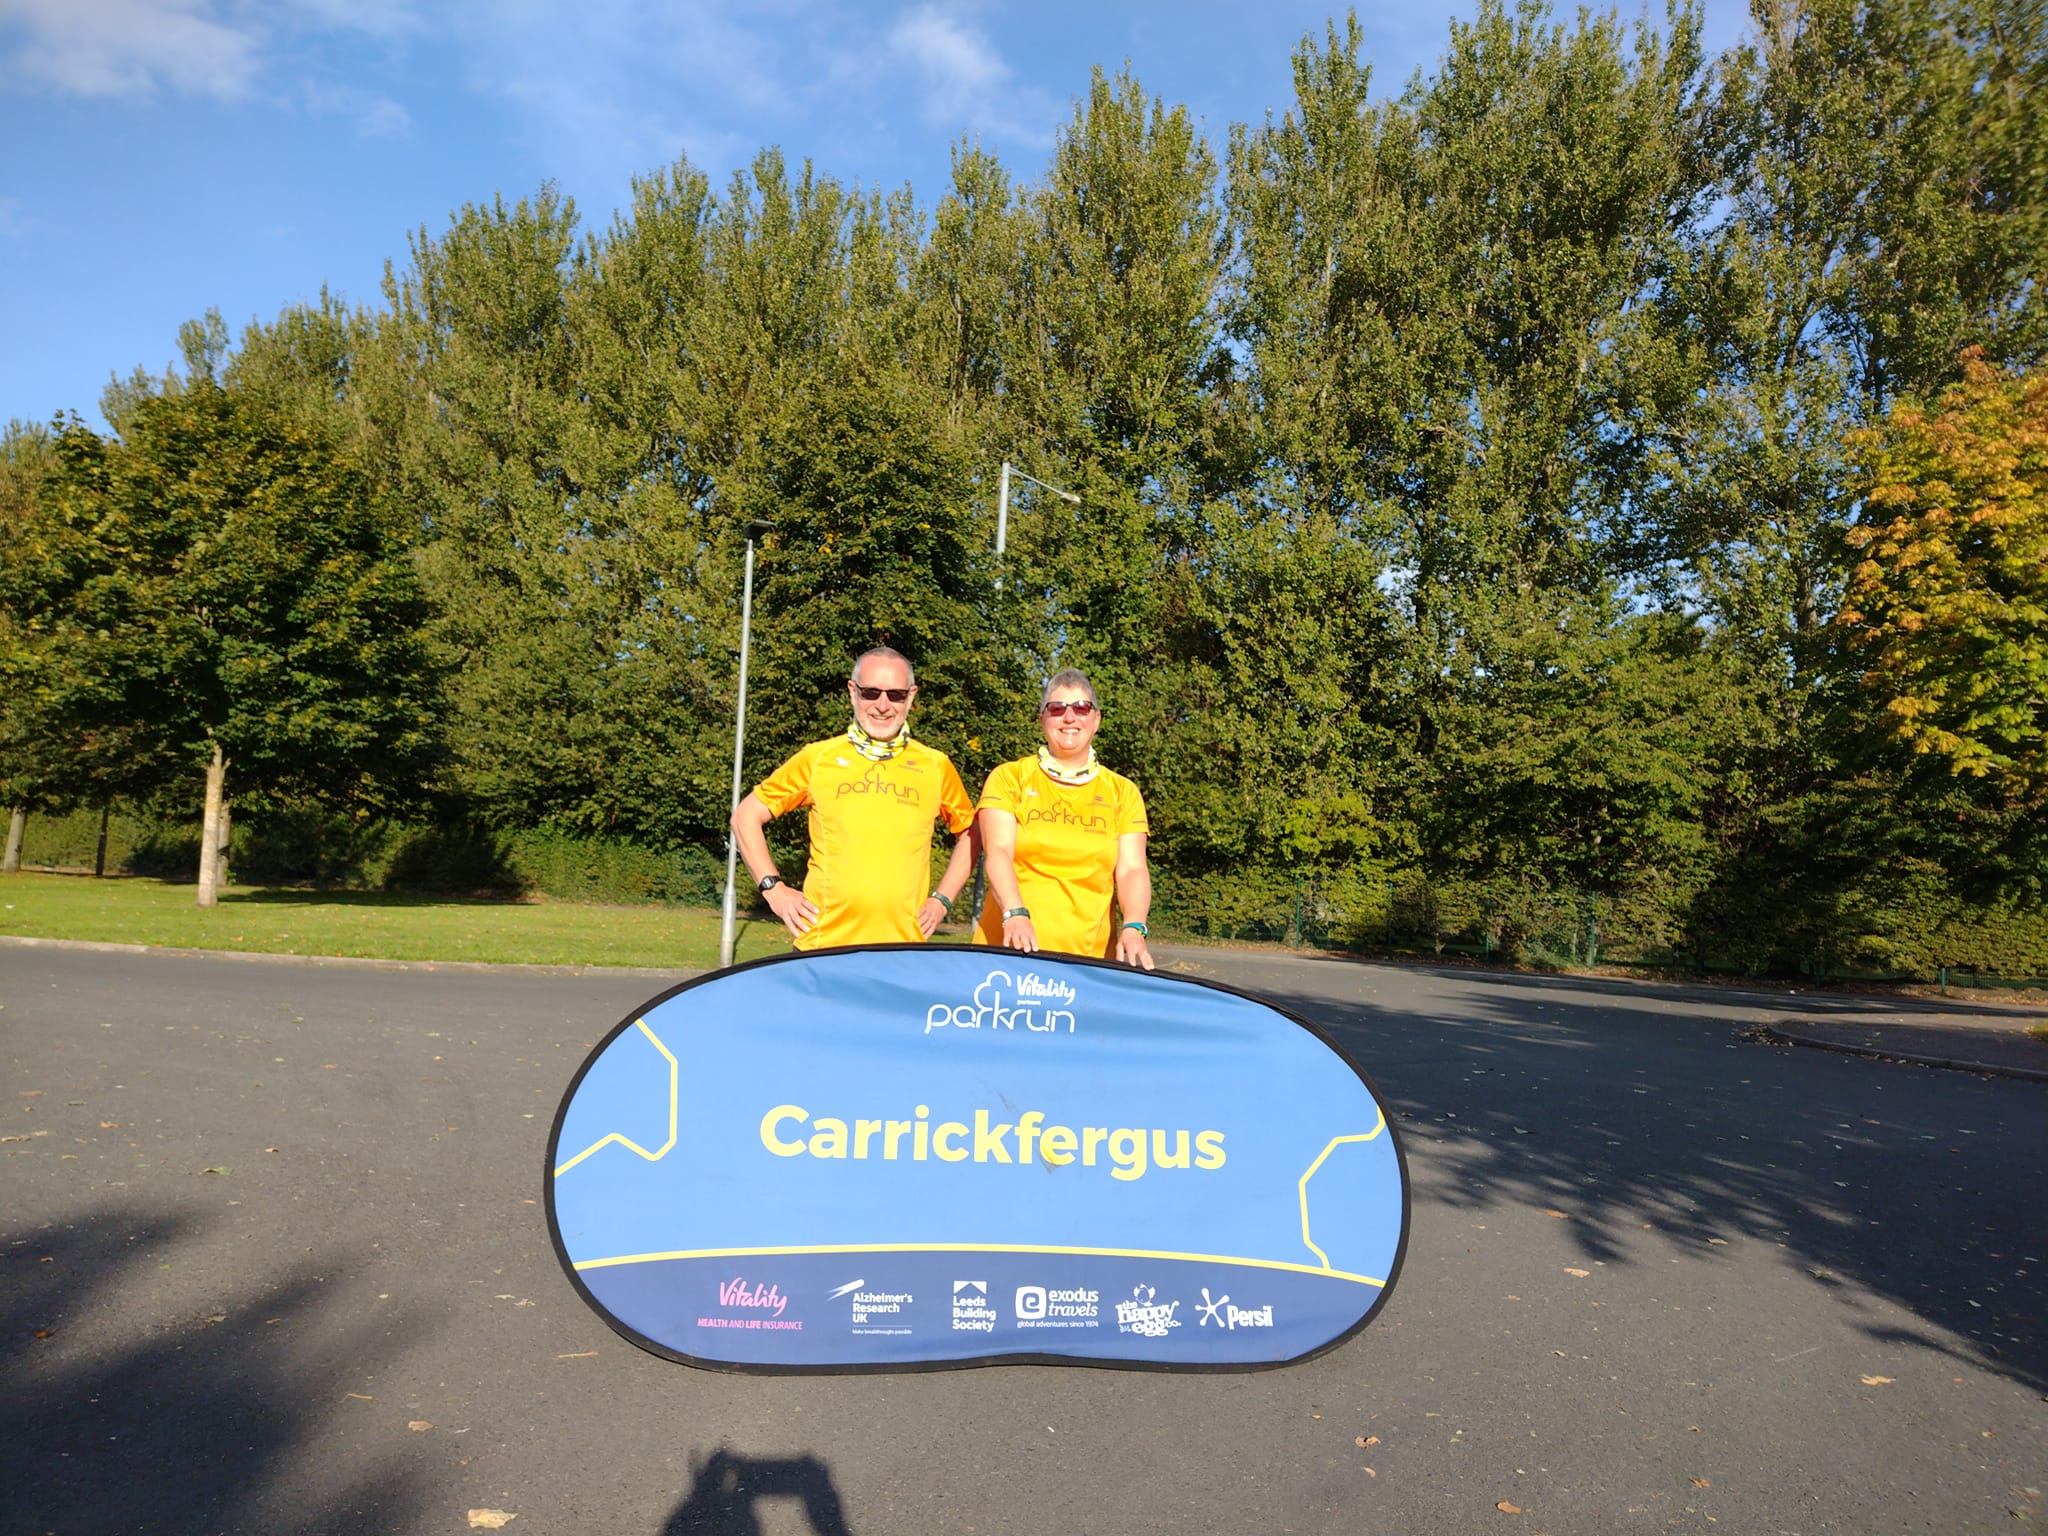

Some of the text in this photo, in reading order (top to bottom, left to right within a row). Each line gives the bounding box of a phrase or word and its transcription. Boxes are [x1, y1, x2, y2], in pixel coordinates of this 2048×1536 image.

[836, 762, 920, 801] parkrun
[1026, 799, 1106, 829] parkrun
[1017, 973, 1076, 1005] Vitality
[925, 970, 1075, 1034] parkrun
[760, 1104, 1227, 1181] Carrickfergus
[720, 1277, 787, 1317] Vitality
[853, 1292, 913, 1303] Alzheimer's
[953, 1295, 987, 1307] Leeds
[1048, 1287, 1099, 1302] exodus
[853, 1303, 900, 1313] Research
[1048, 1302, 1098, 1317] travels
[1115, 1300, 1180, 1324] happy
[1122, 1300, 1138, 1310] the
[852, 1313, 868, 1323] UK
[953, 1307, 996, 1321] Building
[1227, 1305, 1273, 1330] Persil
[698, 1318, 803, 1330] HEALTH AND LIFE INSURANCE
[952, 1319, 995, 1332] Society
[1017, 1320, 1035, 1328] global
[1036, 1320, 1069, 1328] adventures
[1131, 1320, 1168, 1336] egg
